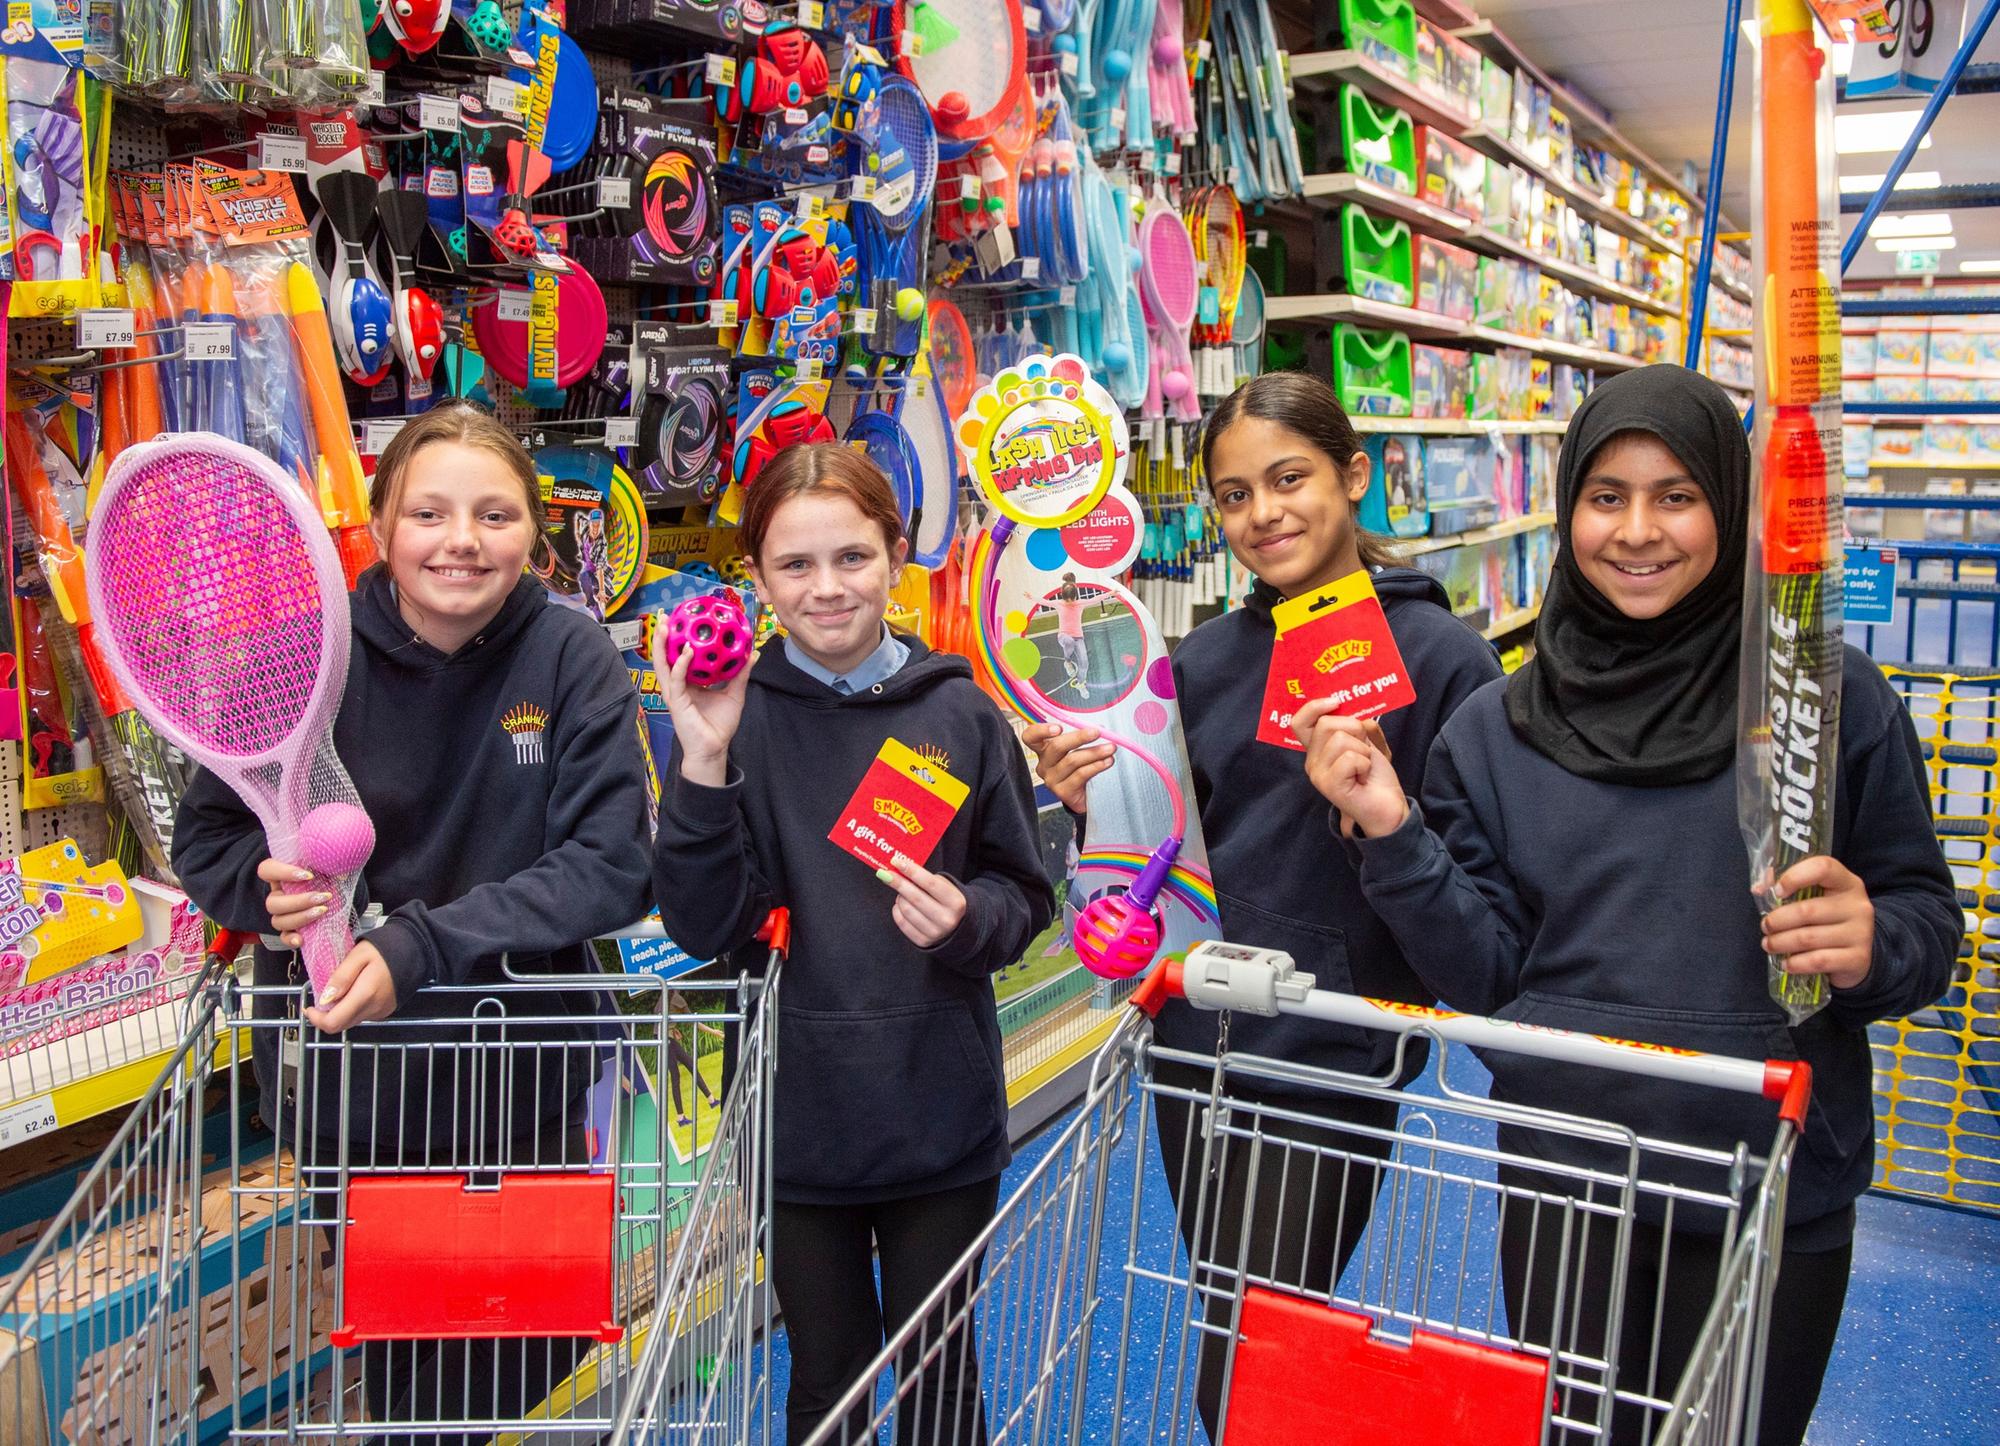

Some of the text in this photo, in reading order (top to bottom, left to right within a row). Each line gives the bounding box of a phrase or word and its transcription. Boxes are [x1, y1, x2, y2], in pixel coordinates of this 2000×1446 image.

[311, 122, 346, 134] WHISTLER
[437, 118, 456, 127] £5.00
[266, 123, 300, 136] WHIST
[316, 133, 344, 144] ROCKET
[667, 131, 697, 146] FLYING
[282, 159, 305, 169] £5.99
[220, 197, 287, 217] WHISTLE
[235, 208, 288, 226] ROCKET
[512, 307, 530, 317] £7.49
[531, 310, 546, 318] PRICE
[105, 332, 133, 342] £7.99
[640, 330, 666, 340] ARENA
[206, 345, 231, 355] £7.99
[692, 365, 715, 374] FLYING
[748, 380, 774, 391] BALL
[988, 435, 1047, 471] LASH
[992, 438, 1126, 493] KIPPING BAL
[1089, 515, 1130, 528] LIGHTS
[650, 532, 709, 555] BOUNCE
[1862, 566, 1880, 577] for
[1849, 579, 1877, 592] only.
[1315, 640, 1371, 673] SMYTHS
[1352, 683, 1373, 698] for
[1373, 672, 1399, 693] you
[503, 715, 546, 730] CRANHILL
[1269, 710, 1279, 723] A
[1778, 668, 1823, 853] ROCKET
[52, 779, 87, 794] eolo
[874, 799, 922, 835] SMYTHS
[847, 819, 857, 831] A
[854, 825, 878, 844] gift
[876, 838, 894, 854] for
[630, 946, 659, 963] reach,
[639, 964, 653, 974] for
[65, 967, 152, 1017] Baton
[25, 1115, 56, 1134] £2.49
